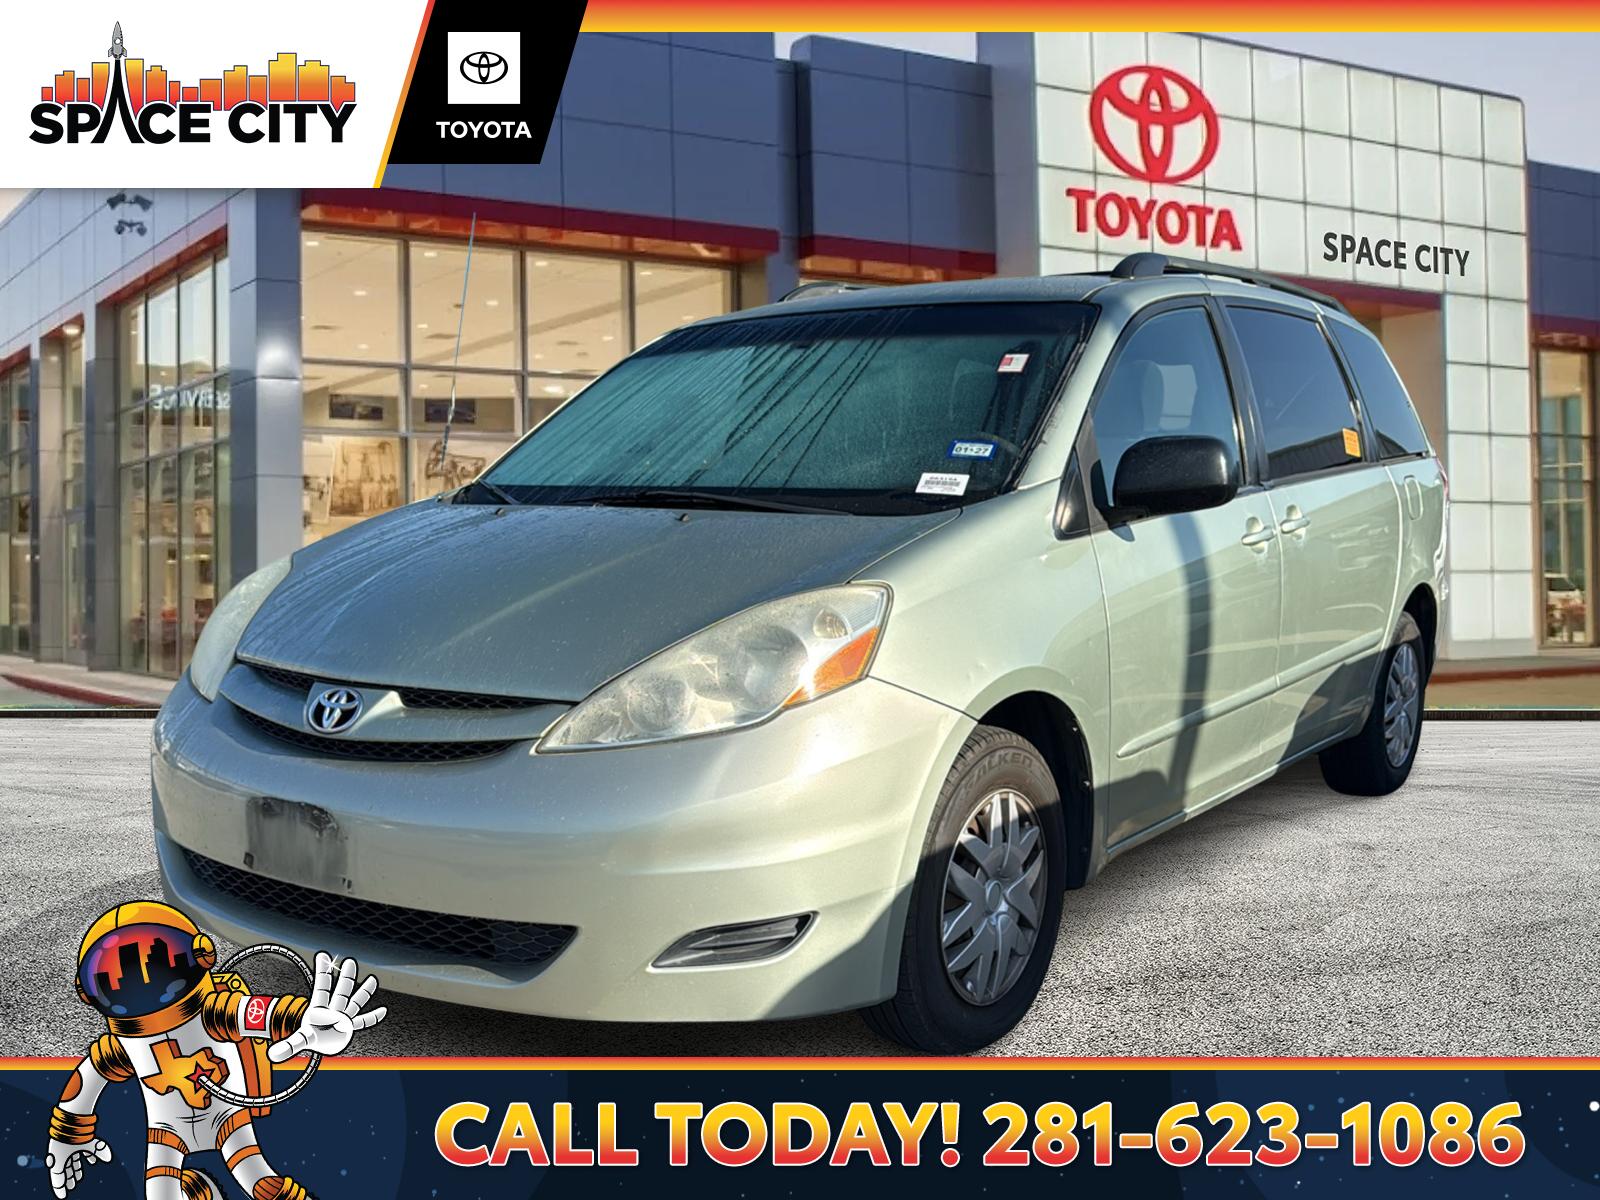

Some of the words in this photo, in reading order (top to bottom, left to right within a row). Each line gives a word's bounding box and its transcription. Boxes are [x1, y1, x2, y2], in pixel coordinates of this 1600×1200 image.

[1066, 187, 1242, 251] TOYOTA
[1323, 232, 1407, 270] SPACE
[1414, 243, 1471, 277] CITY
